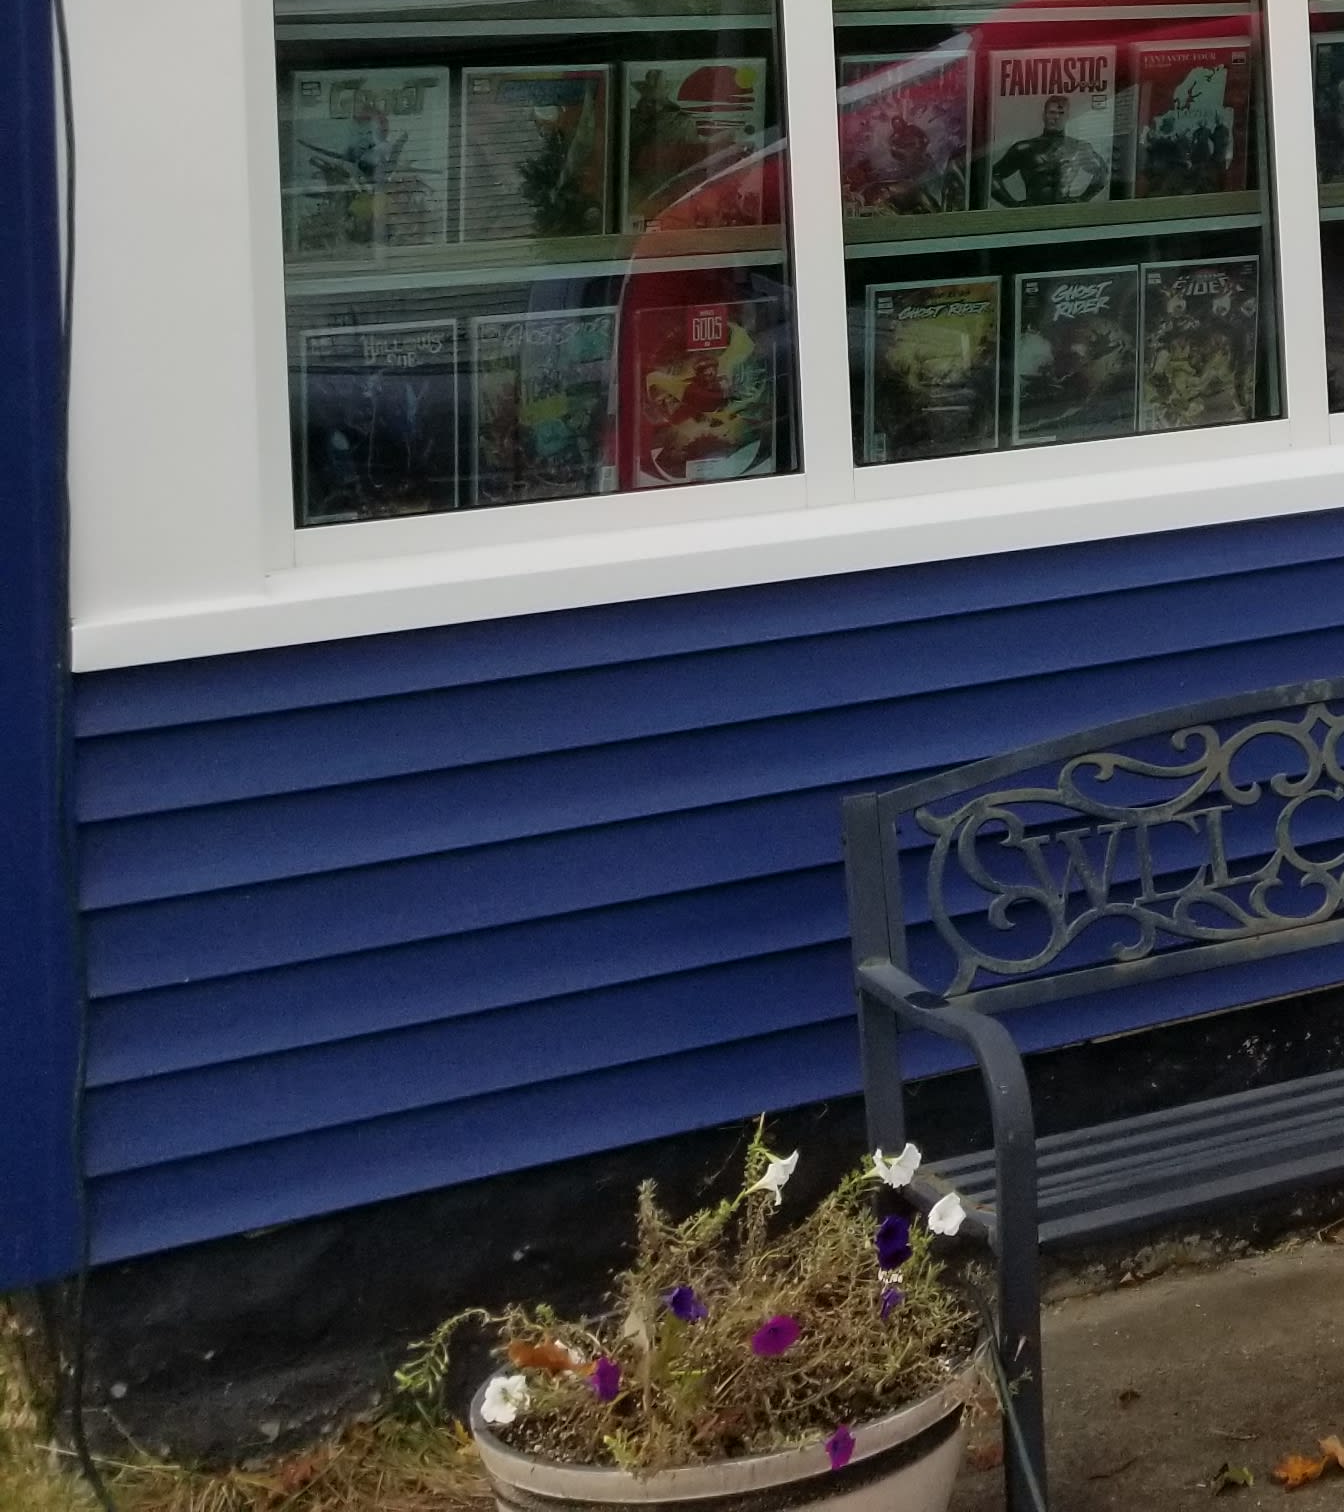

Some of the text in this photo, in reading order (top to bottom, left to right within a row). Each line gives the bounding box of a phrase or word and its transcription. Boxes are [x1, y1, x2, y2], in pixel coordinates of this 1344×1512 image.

[1144, 54, 1190, 64] FANTASTIC
[1000, 56, 1108, 96] FANTASTIC
[1051, 280, 1112, 303] GHOST
[898, 301, 991, 321] GHOST RIDER
[1053, 296, 1110, 321] RIDER
[692, 316, 722, 341] GODS
